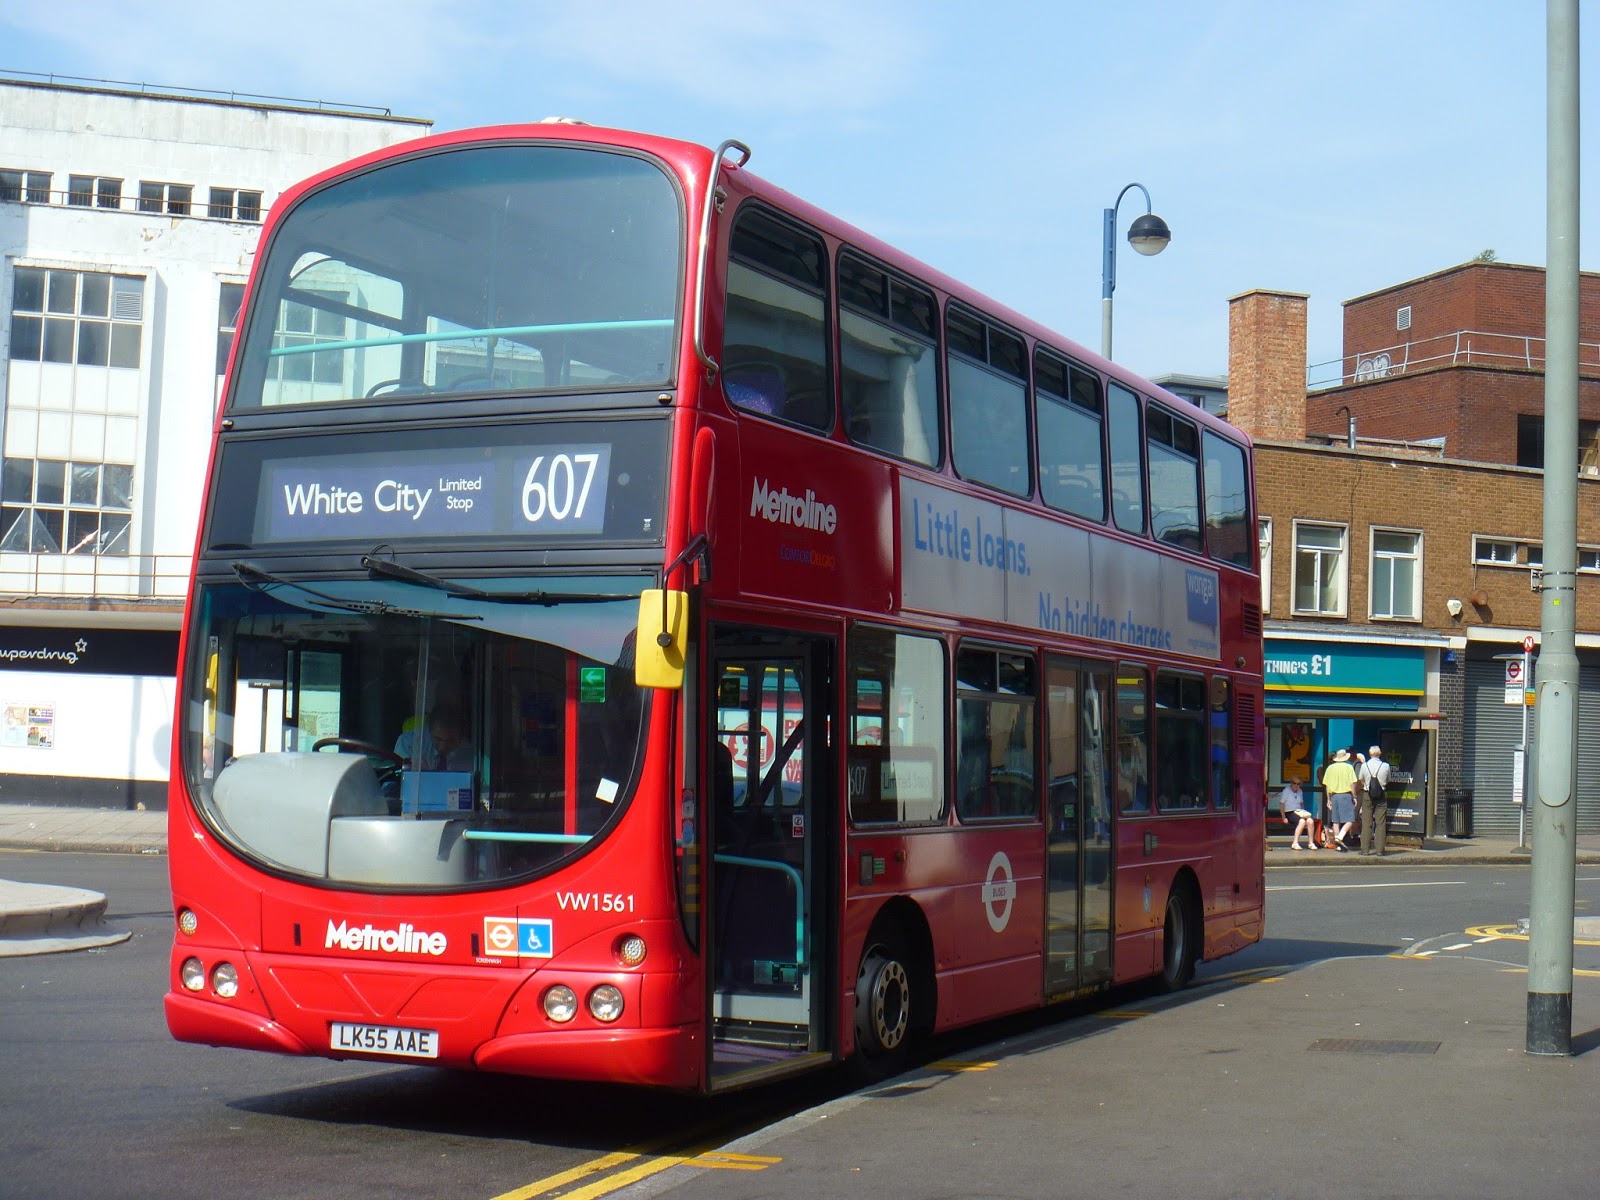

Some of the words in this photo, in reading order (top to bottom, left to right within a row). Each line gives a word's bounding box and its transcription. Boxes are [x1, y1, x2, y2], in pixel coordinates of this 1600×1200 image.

[439, 476, 481, 492] Limited
[522, 453, 599, 522] 607
[285, 483, 362, 515] White
[374, 480, 432, 520] City
[446, 495, 473, 512] Stop
[750, 476, 837, 535] Metroline
[913, 498, 971, 562] Little
[977, 516, 1031, 576] loans.
[1187, 573, 1212, 604] wonga
[1039, 592, 1060, 632] No
[1065, 596, 1116, 642] hidden
[1120, 610, 1171, 650] charges
[0, 647, 78, 664] uperdrug
[1264, 660, 1308, 674] THING'S
[1311, 654, 1332, 675] £1
[850, 766, 867, 796] 607
[556, 892, 635, 913] VW1561
[993, 887, 1006, 898] BUSES
[325, 919, 447, 956] Metroline
[339, 1025, 388, 1050] LK55
[394, 1030, 430, 1053] AAE
